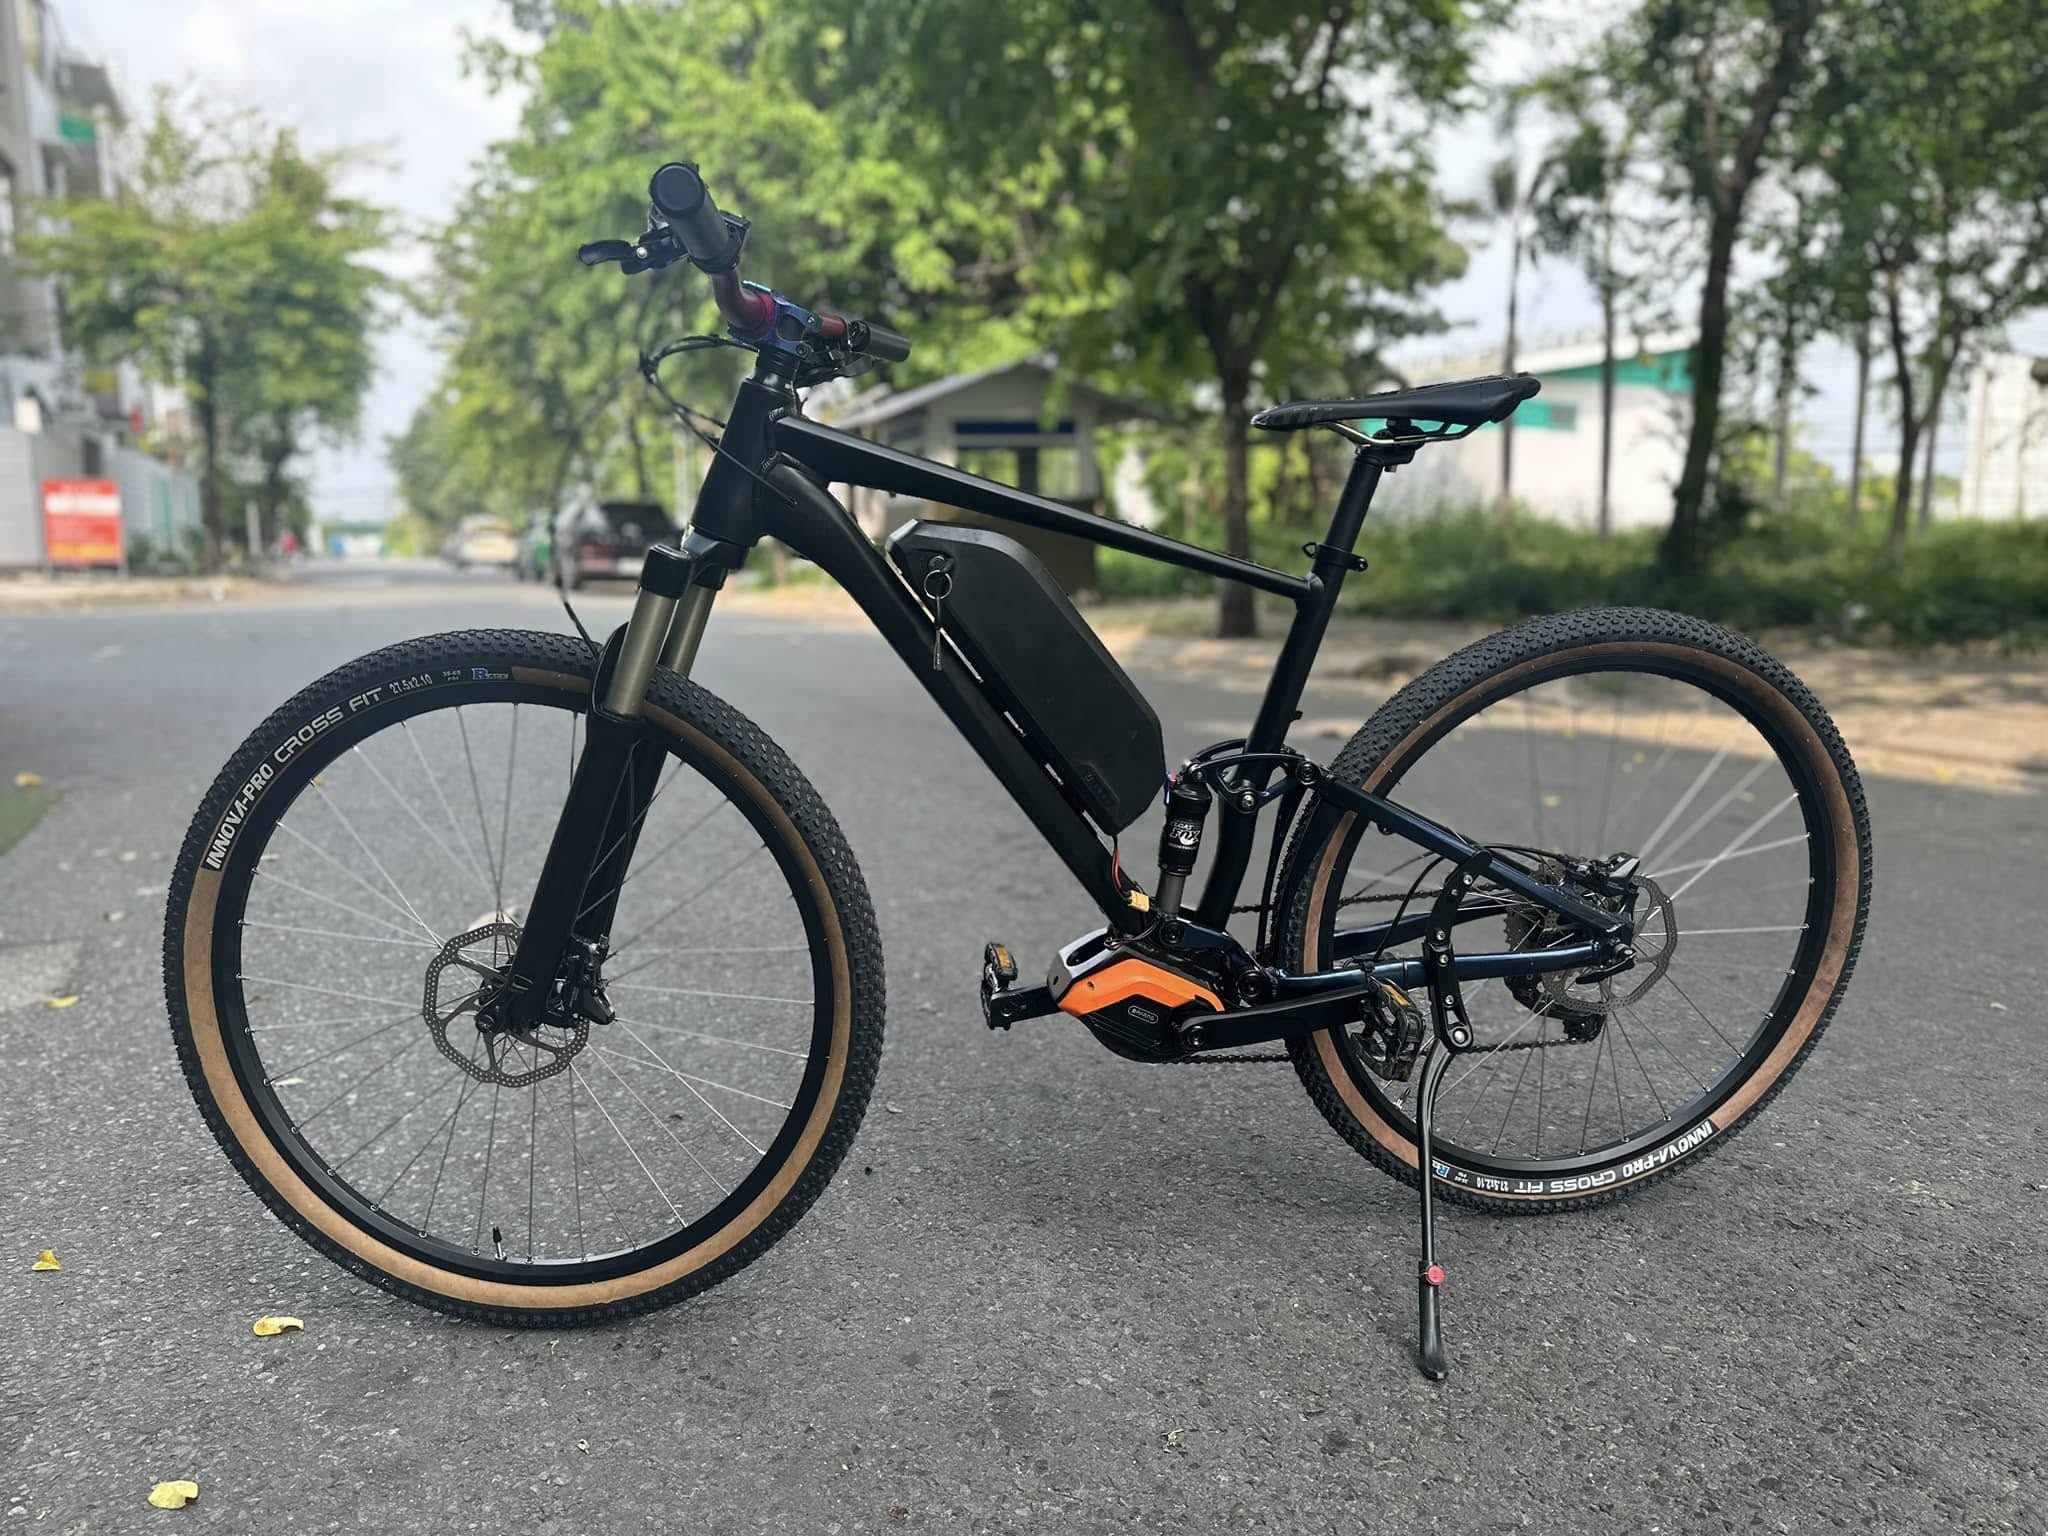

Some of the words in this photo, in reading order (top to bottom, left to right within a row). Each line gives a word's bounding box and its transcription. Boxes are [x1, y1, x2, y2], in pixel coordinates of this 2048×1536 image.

[206, 763, 274, 869] INNOVA-PRO
[274, 706, 344, 764] CROSS
[349, 687, 382, 712] FIT
[390, 673, 432, 696] 27.5x2.10
[1169, 827, 1200, 846] FOX
[1622, 1121, 1712, 1179] INNOVA-PRO
[1476, 1176, 1509, 1192] 27.5x2.10
[1514, 1180, 1544, 1194] FIT
[1550, 1170, 1616, 1194] CROSS
